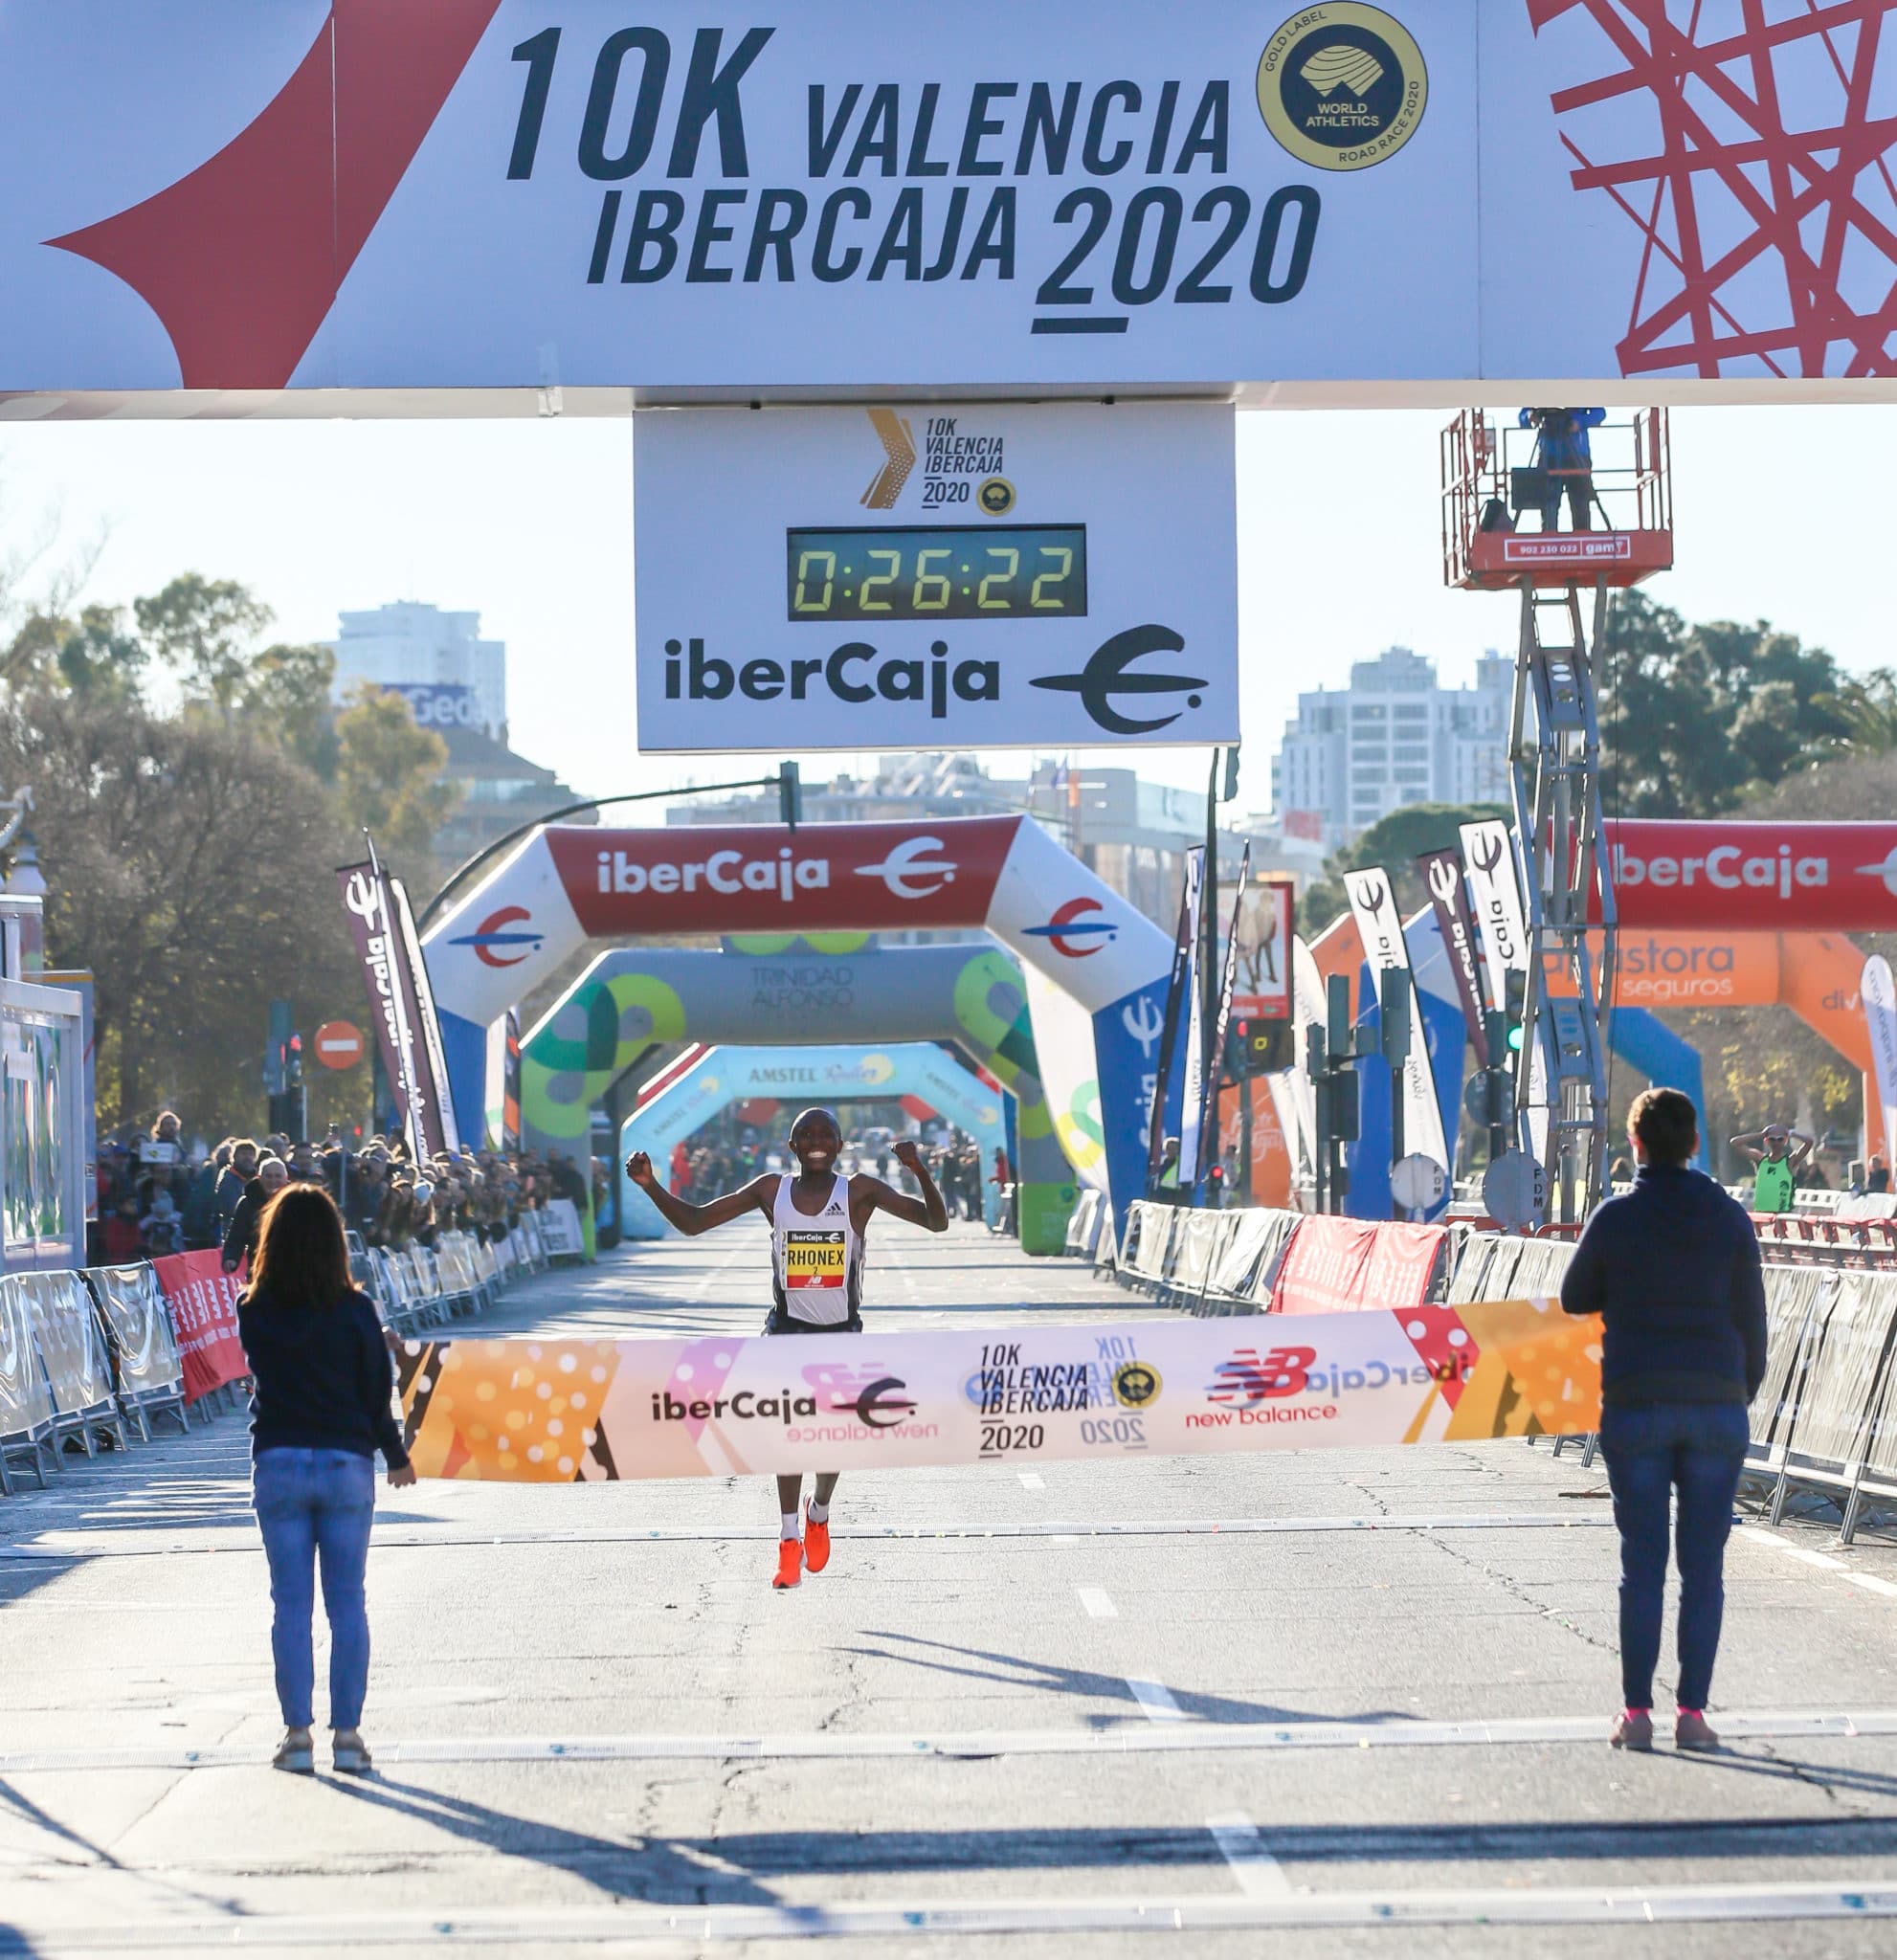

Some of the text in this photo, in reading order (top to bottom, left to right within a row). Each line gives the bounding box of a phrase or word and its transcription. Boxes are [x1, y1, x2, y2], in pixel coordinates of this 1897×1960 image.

[1265, 10, 1328, 72] GOLD LABEL
[507, 27, 1231, 181] 10K VALENCIA
[1317, 103, 1368, 114] WORLD
[1306, 116, 1379, 126] ATHLETICS
[1339, 80, 1419, 162] ROAD RACE 2020
[586, 185, 1322, 307] IBERCAJA 2020
[926, 418, 957, 435] 10K
[926, 437, 1003, 455] VALENCIA
[925, 456, 1003, 473] IBERCAJA
[923, 481, 970, 502] 2020
[793, 546, 1074, 612] 0:26:22
[663, 637, 1001, 719] iberCaja
[596, 847, 830, 902] iberCaja
[1613, 842, 1827, 899] berCaja
[750, 967, 854, 986] TRINIDAD
[1621, 976, 1733, 1000] seguros
[752, 988, 854, 1006] ALFONSO
[748, 1067, 816, 1082] AMSTEL
[792, 1233, 823, 1243] iberCaja
[788, 1250, 844, 1265] RHONEX
[813, 1266, 818, 1275] 2
[982, 1343, 1021, 1367] 10K
[980, 1365, 1088, 1391] VALENCIA
[651, 1389, 816, 1425] iberCaja
[980, 1388, 1088, 1414] IBERCAJA
[1185, 1403, 1337, 1428] new balance
[980, 1425, 1044, 1452] 2020
